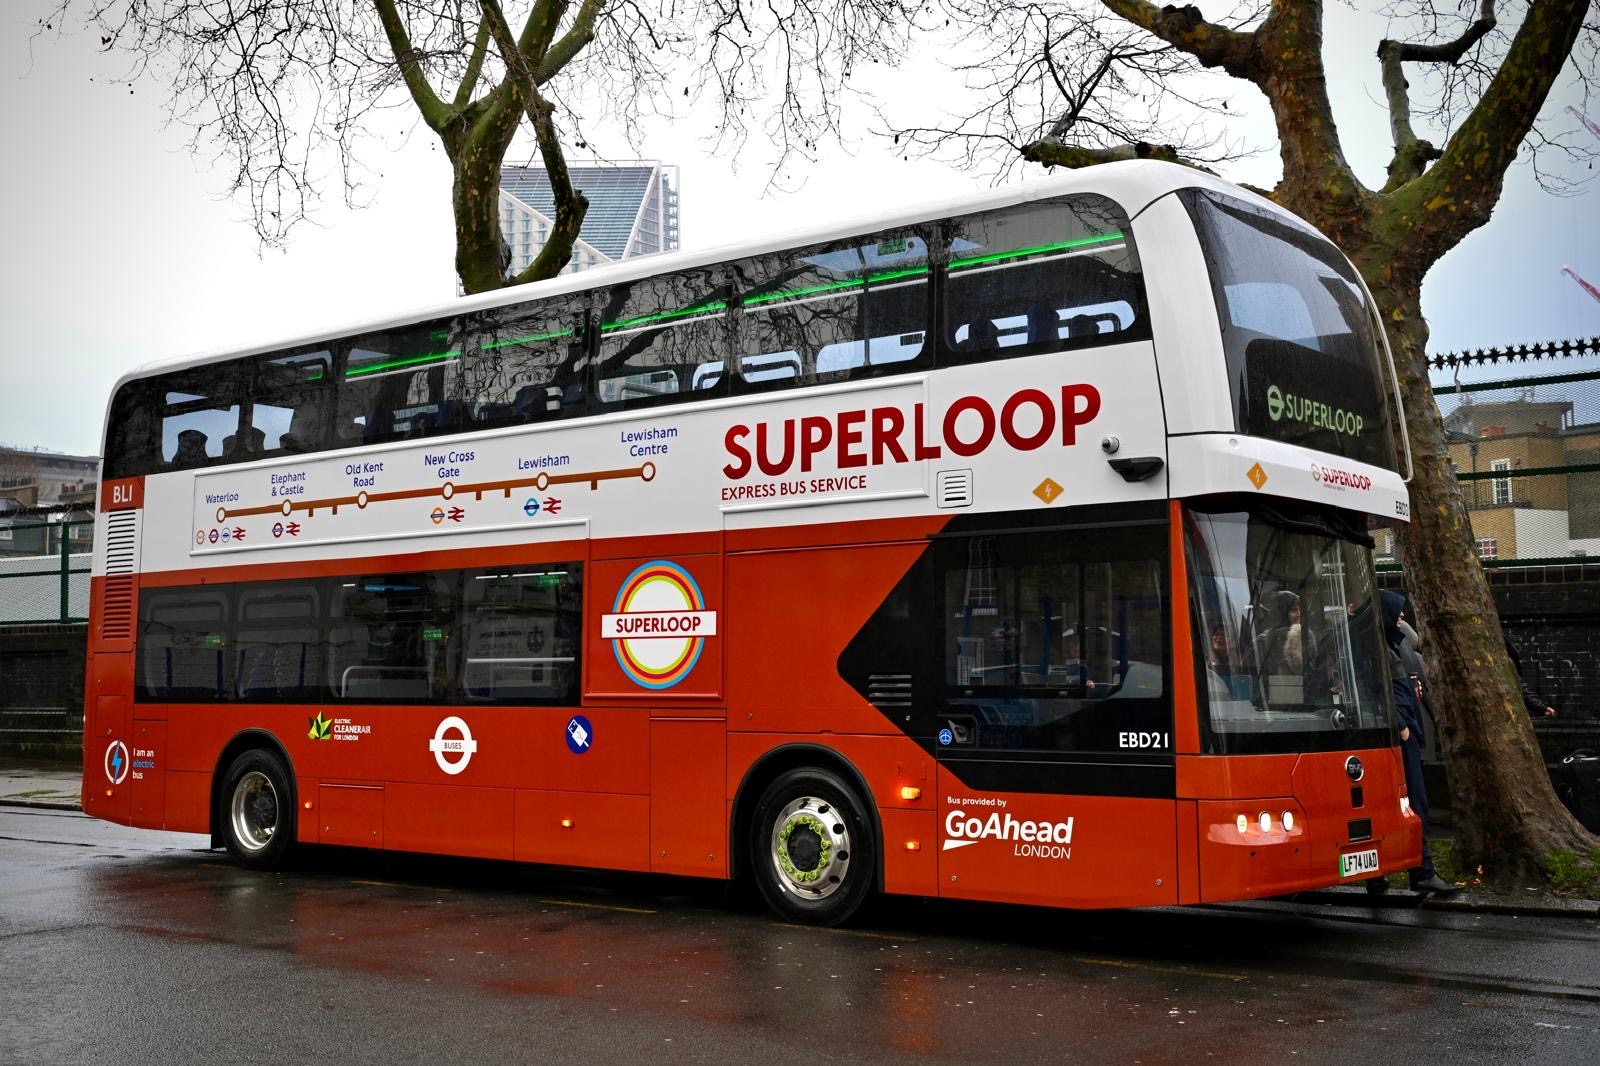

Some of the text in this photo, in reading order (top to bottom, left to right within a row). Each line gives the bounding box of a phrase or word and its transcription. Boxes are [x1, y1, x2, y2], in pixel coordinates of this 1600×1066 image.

[1286, 393, 1363, 437] SUPERLOOP
[620, 427, 678, 443] Lewisham
[722, 383, 1101, 480] SUPERLOOP
[629, 443, 668, 457] Centre
[424, 450, 475, 466] New Cross
[518, 454, 570, 470] Lewisham
[345, 461, 384, 475] Old Kent
[438, 467, 460, 479] Gate
[271, 472, 306, 485] Elephant
[353, 476, 374, 487] Road
[1321, 467, 1371, 491] SUPERLOOP
[271, 484, 304, 497] & Castle
[721, 475, 867, 500] EXPRESS BUS SERVICE
[205, 492, 239, 504] Waterloo
[615, 616, 701, 633] SUPERLOOP
[1119, 732, 1169, 748] EBD21
[132, 759, 155, 769] electric
[132, 770, 143, 779] bus
[962, 797, 995, 807] provided
[997, 798, 1007, 807] by
[945, 810, 1074, 844] GoAhead
[1014, 844, 1071, 859] LONDON
[1343, 852, 1377, 873] LF74 UAD
